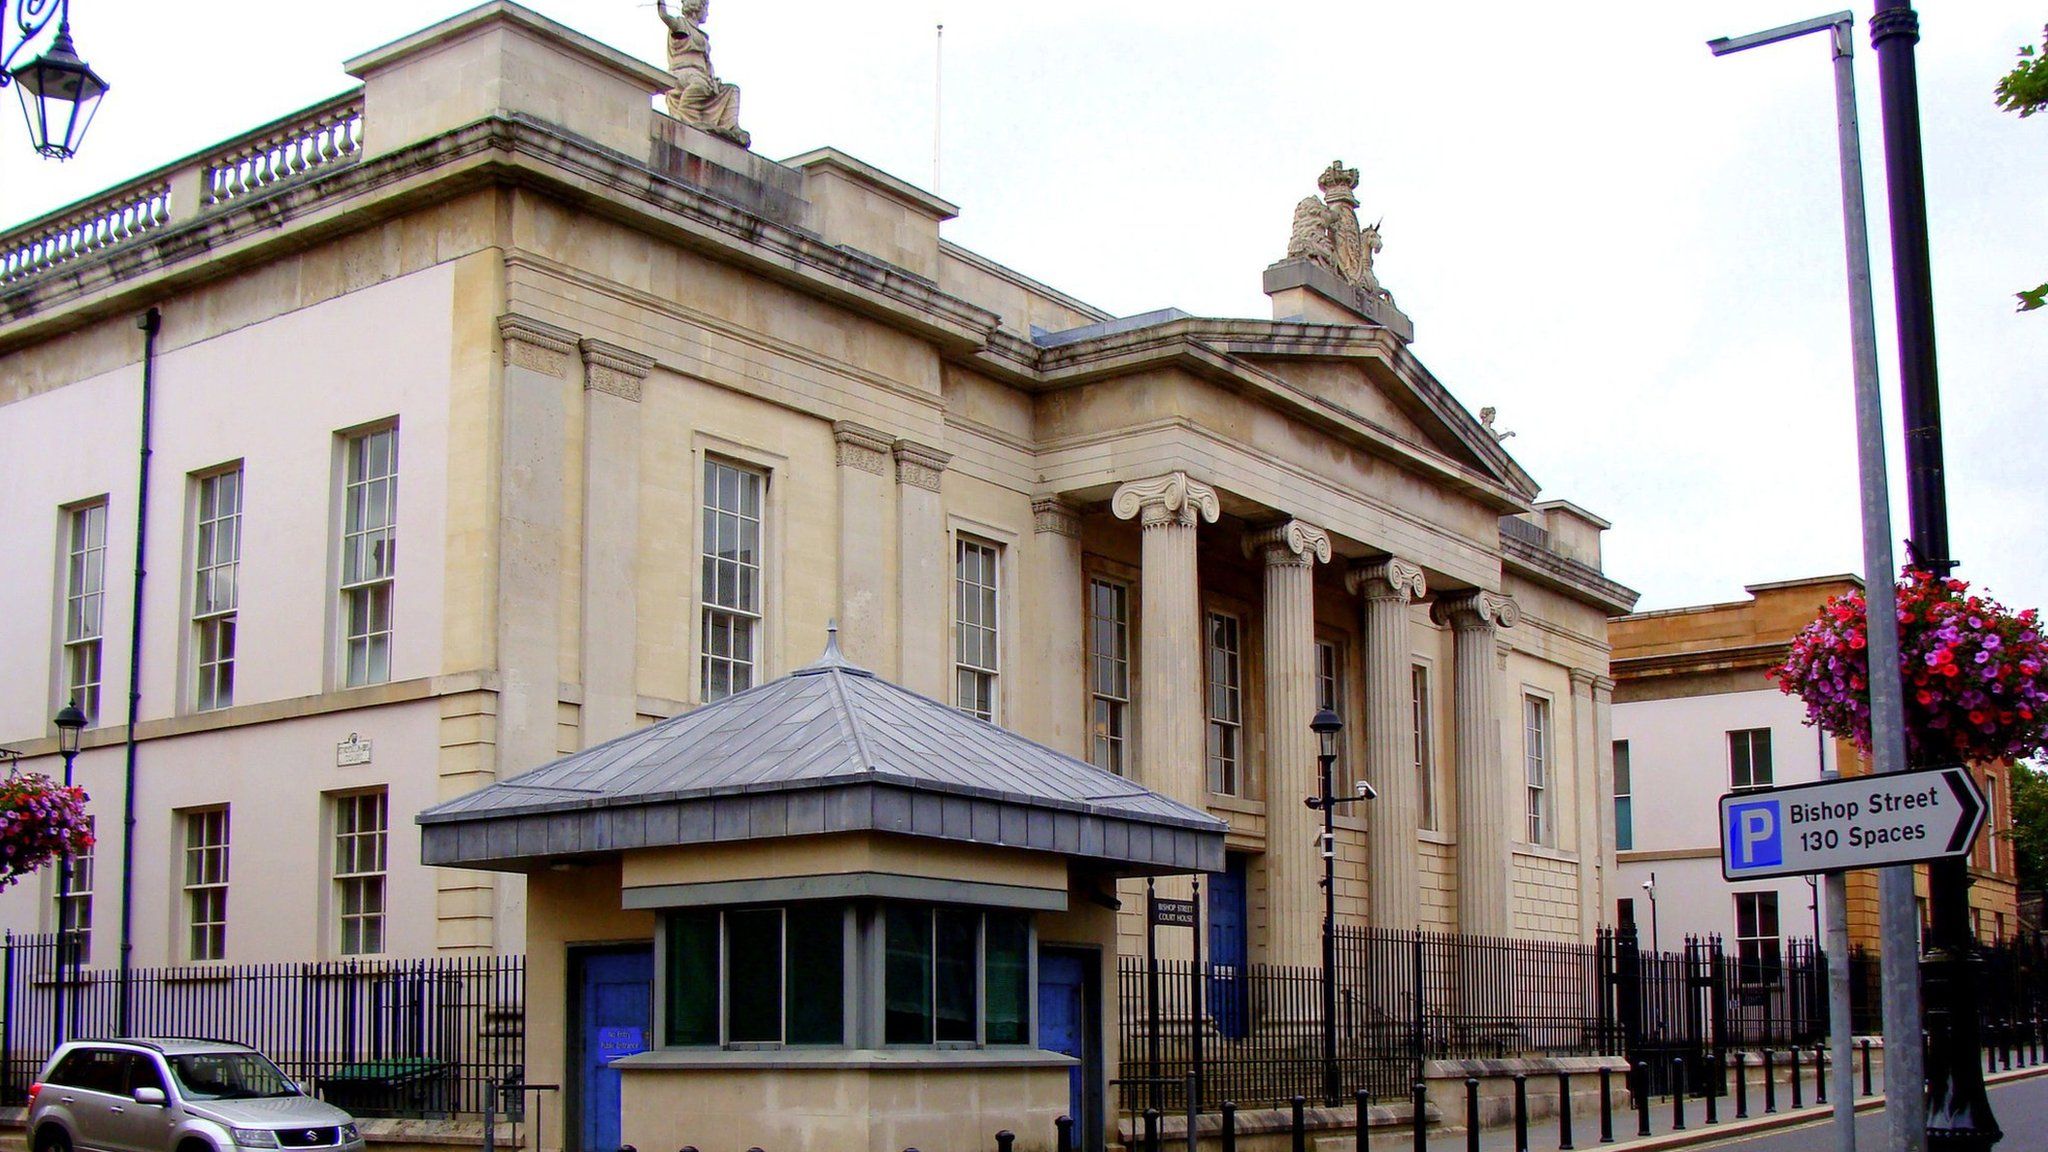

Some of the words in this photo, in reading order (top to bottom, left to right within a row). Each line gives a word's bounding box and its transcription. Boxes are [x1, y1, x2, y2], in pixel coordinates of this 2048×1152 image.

[1790, 801, 1859, 824] Bishop
[1868, 787, 1939, 814] Street
[1740, 808, 1774, 863] P
[1800, 831, 1839, 852] 130
[1849, 824, 1926, 849] Spaces
[1158, 903, 1176, 911] BISHOP
[1177, 904, 1193, 913] STREET
[1158, 913, 1176, 921] COURT
[1176, 914, 1193, 922] HOUSE
